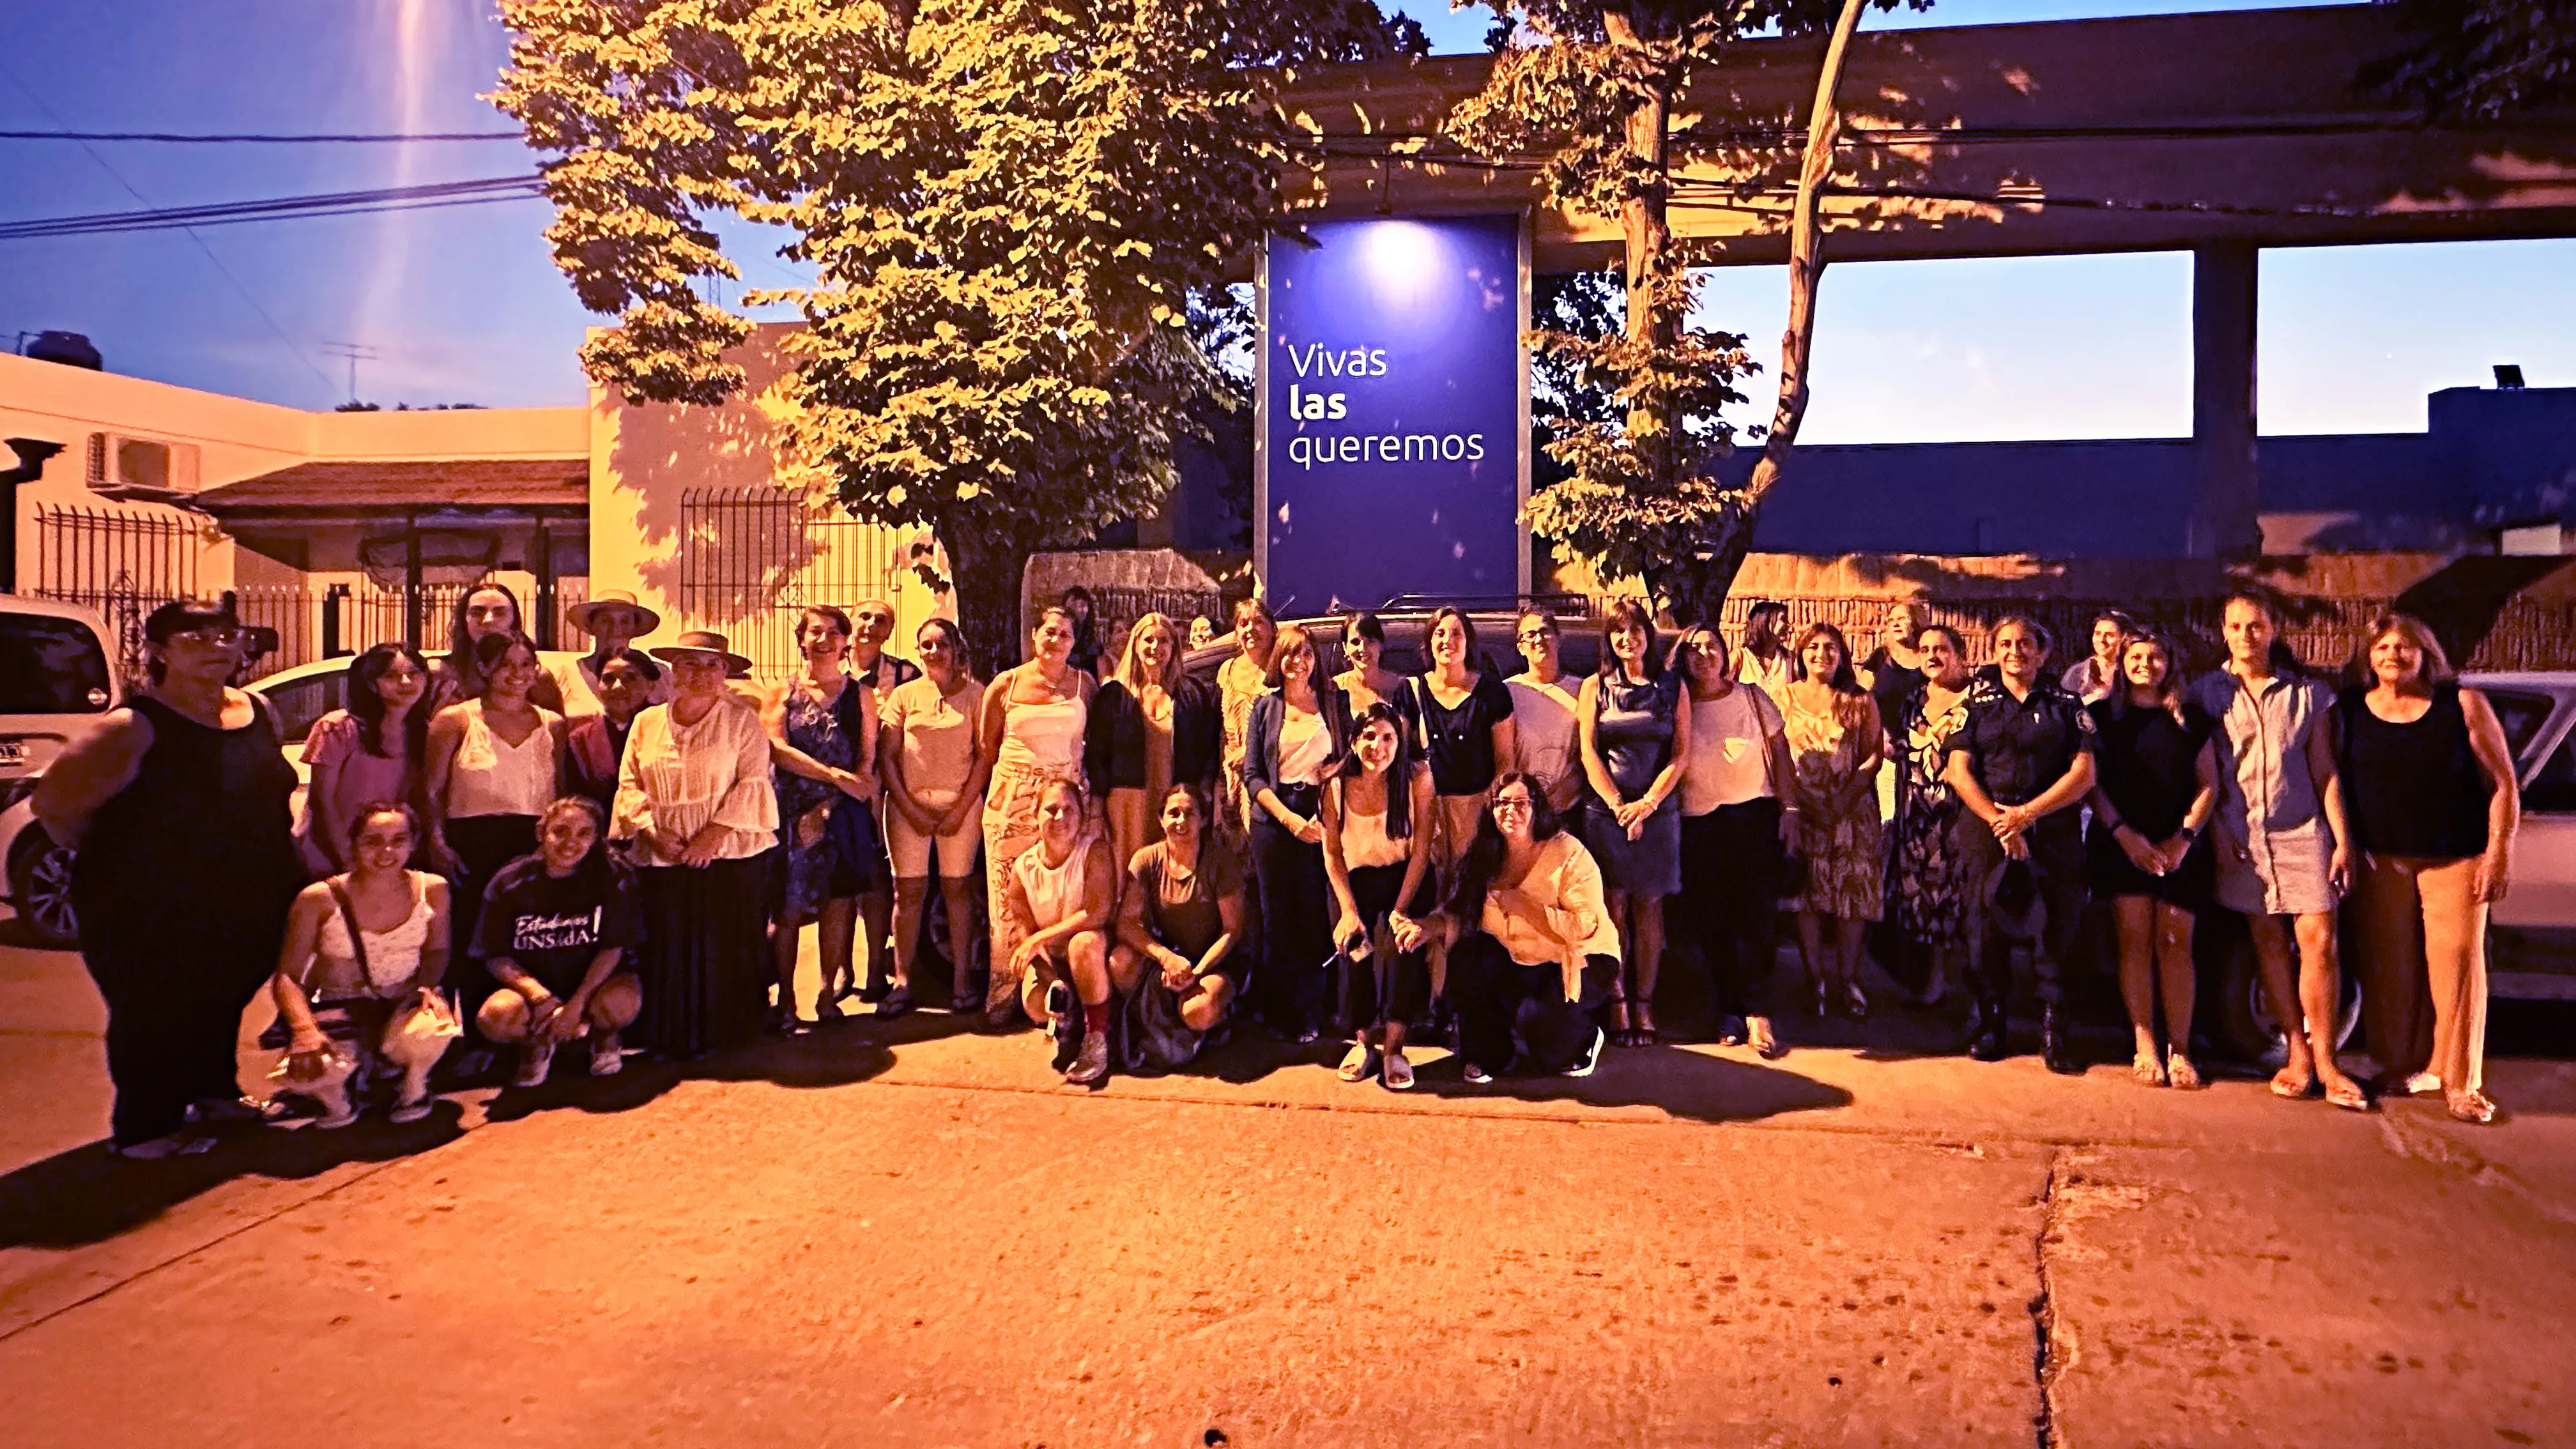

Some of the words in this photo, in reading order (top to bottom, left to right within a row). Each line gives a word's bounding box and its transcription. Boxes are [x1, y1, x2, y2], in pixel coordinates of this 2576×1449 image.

[1288, 342, 1388, 378] Vivas
[1289, 384, 1347, 420] las
[1289, 433, 1484, 470] queremos
